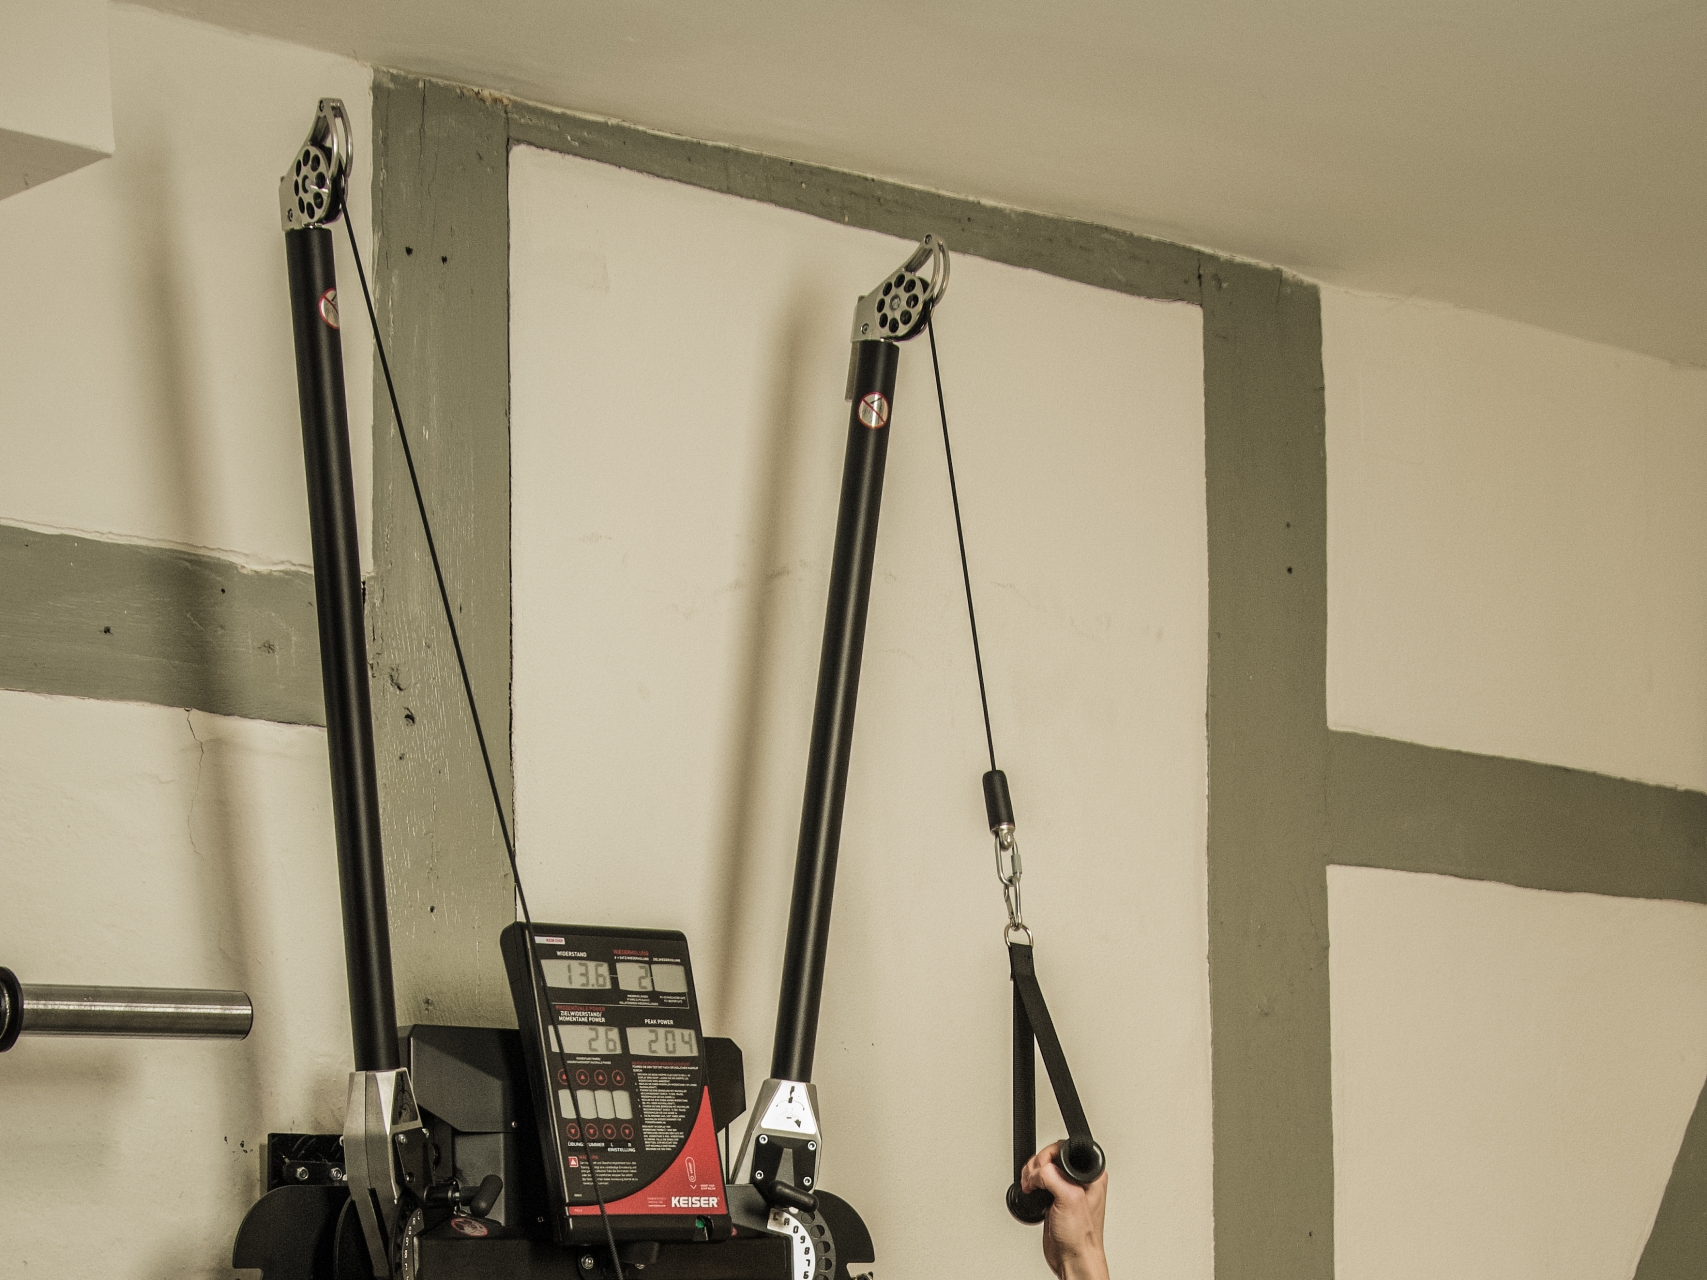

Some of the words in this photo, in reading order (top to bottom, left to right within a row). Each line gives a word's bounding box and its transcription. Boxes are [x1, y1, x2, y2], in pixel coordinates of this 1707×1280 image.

[568, 963, 606, 987] 13.6
[638, 965, 648, 989] 2
[588, 1027, 617, 1052] 26
[648, 1029, 693, 1054] 204
[672, 1196, 718, 1208] KEISER
[800, 1235, 805, 1244] 9
[804, 1247, 810, 1255] 8
[803, 1271, 809, 1280] 6
